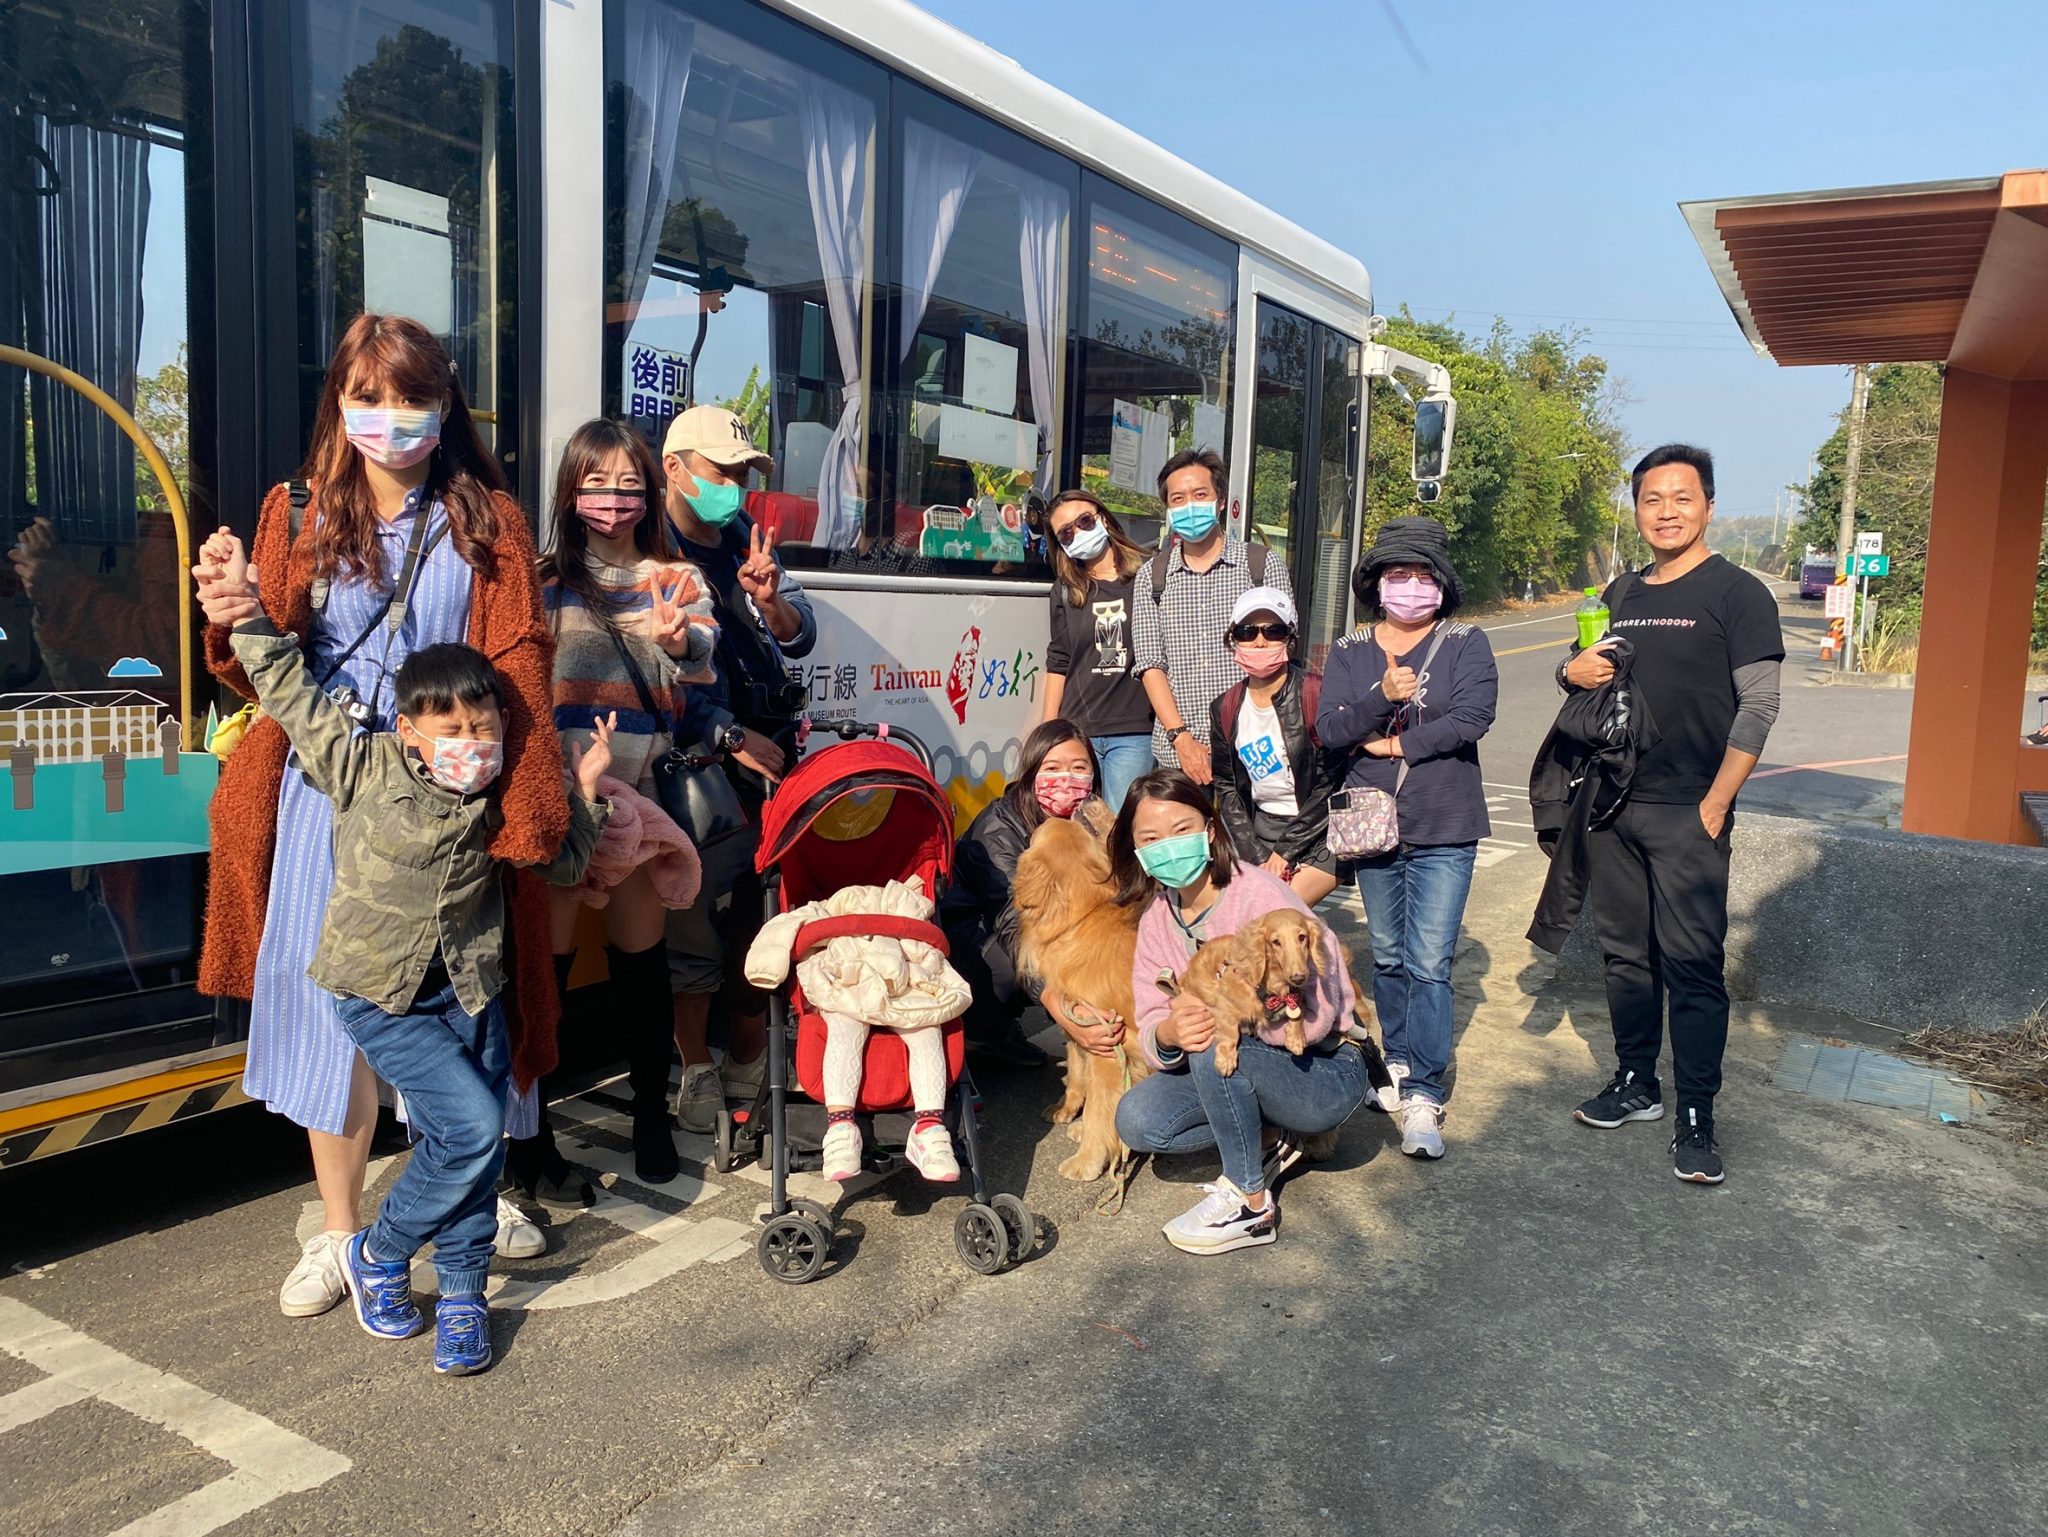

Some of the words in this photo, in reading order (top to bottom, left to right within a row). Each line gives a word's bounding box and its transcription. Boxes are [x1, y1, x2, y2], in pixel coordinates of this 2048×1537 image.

[870, 662, 942, 691] Taiwan
[808, 709, 835, 720] MUSEUM
[836, 707, 857, 719] ROUTE
